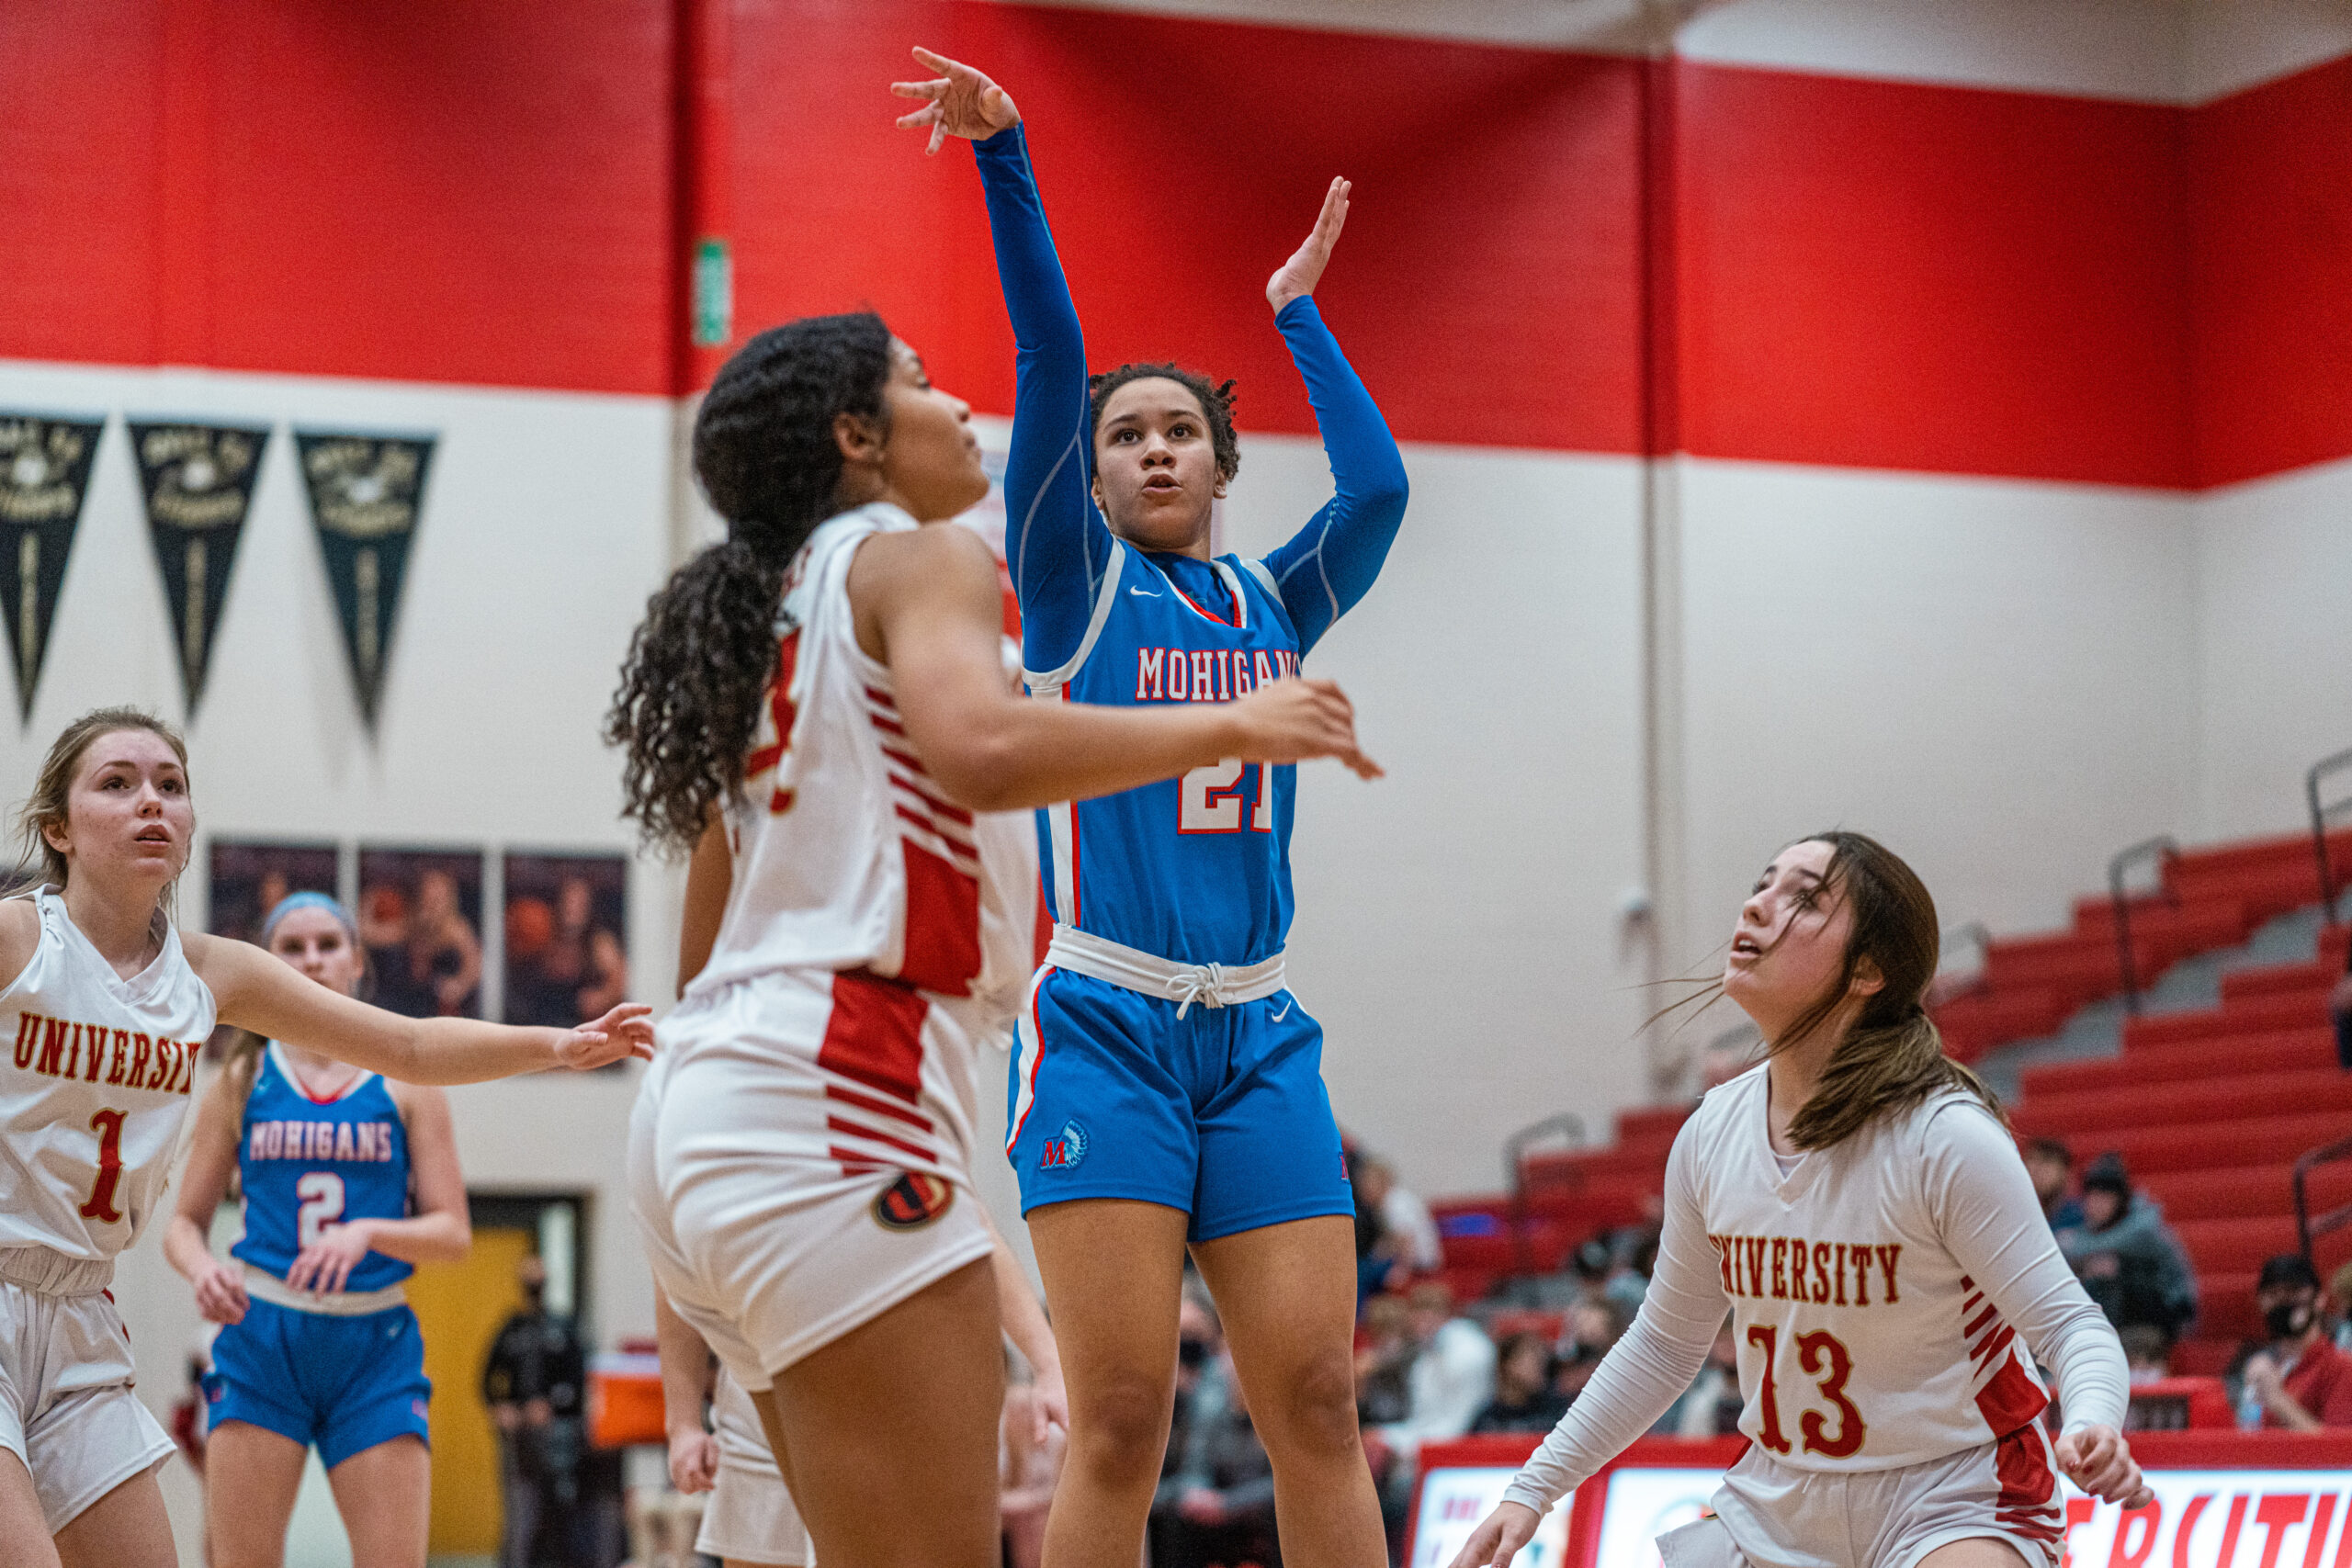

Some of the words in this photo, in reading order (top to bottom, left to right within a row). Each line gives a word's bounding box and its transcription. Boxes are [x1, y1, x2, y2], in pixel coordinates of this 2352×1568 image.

[1136, 647, 1297, 703] MOHIGAN
[78, 1107, 129, 1224] 1
[249, 1120, 392, 1162] MOHIGANS
[296, 1171, 345, 1254] 2
[1747, 1323, 1868, 1461] 13
